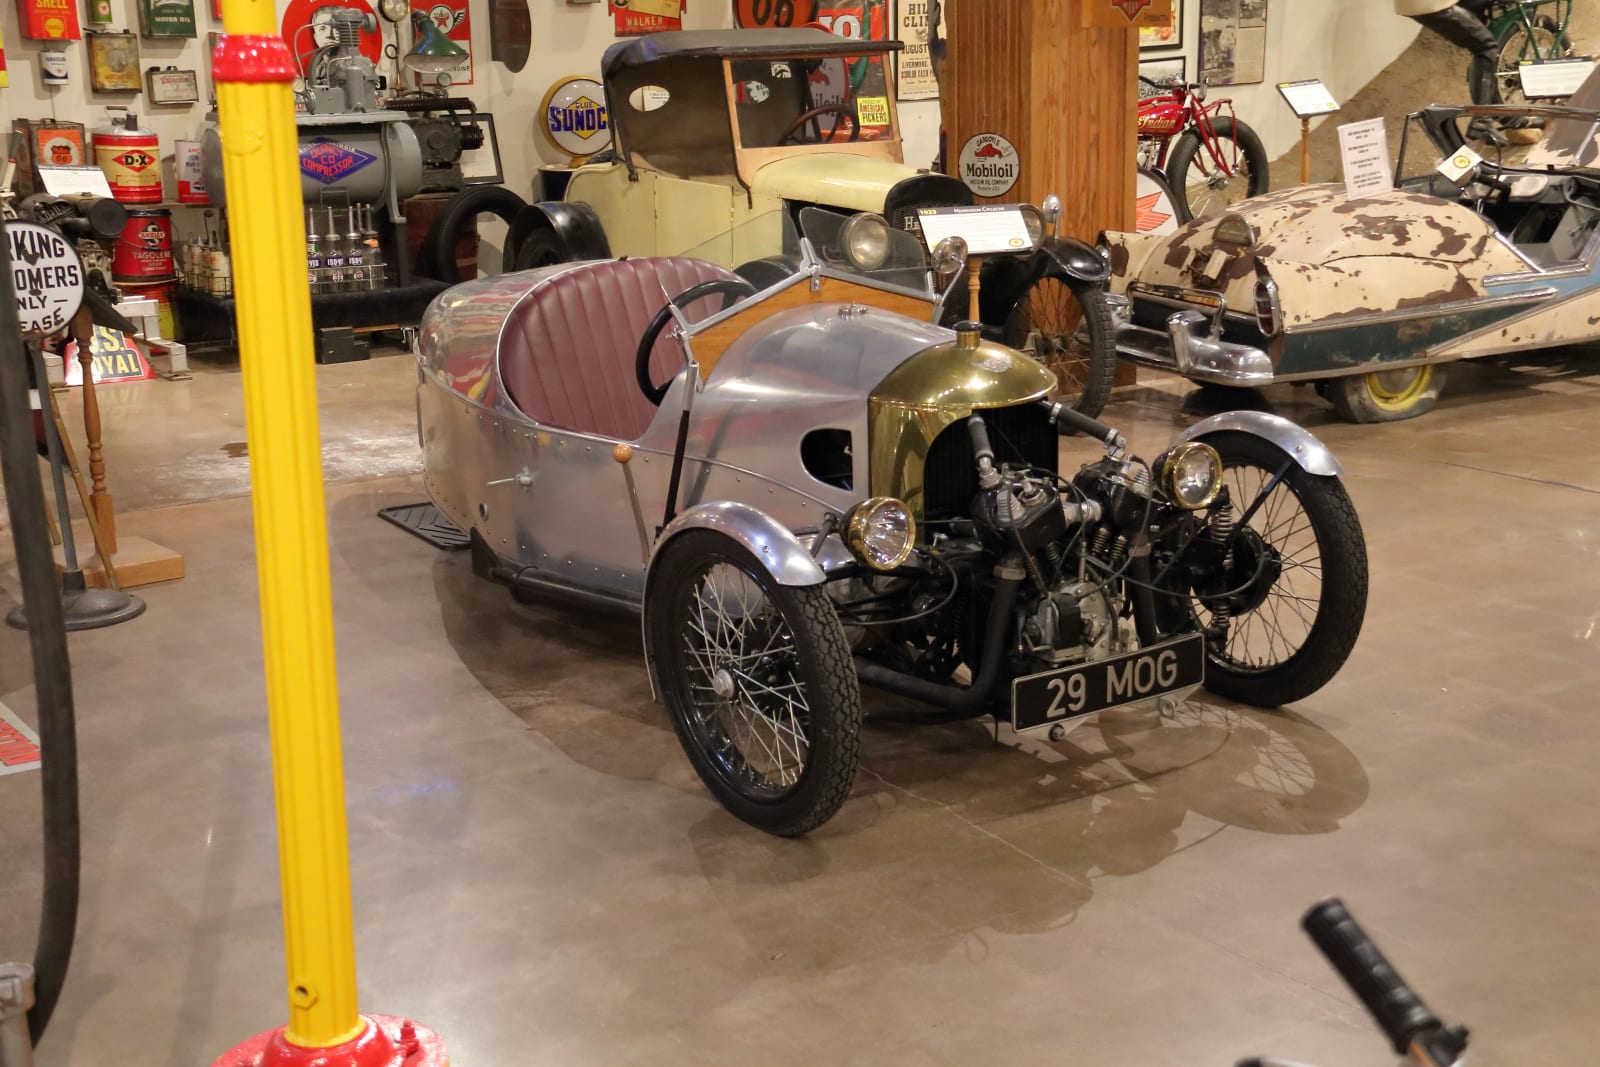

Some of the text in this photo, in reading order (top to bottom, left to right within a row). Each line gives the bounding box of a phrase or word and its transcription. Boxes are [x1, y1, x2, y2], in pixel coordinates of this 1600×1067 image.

[625, 16, 663, 27] WALKER
[550, 106, 608, 131] SUNOC
[1137, 115, 1176, 128] Indian
[303, 156, 353, 177] COMPRESSOR
[966, 163, 1013, 178] Mobiloil
[14, 265, 79, 291] OMERS
[1046, 649, 1178, 719] 29 MOG
